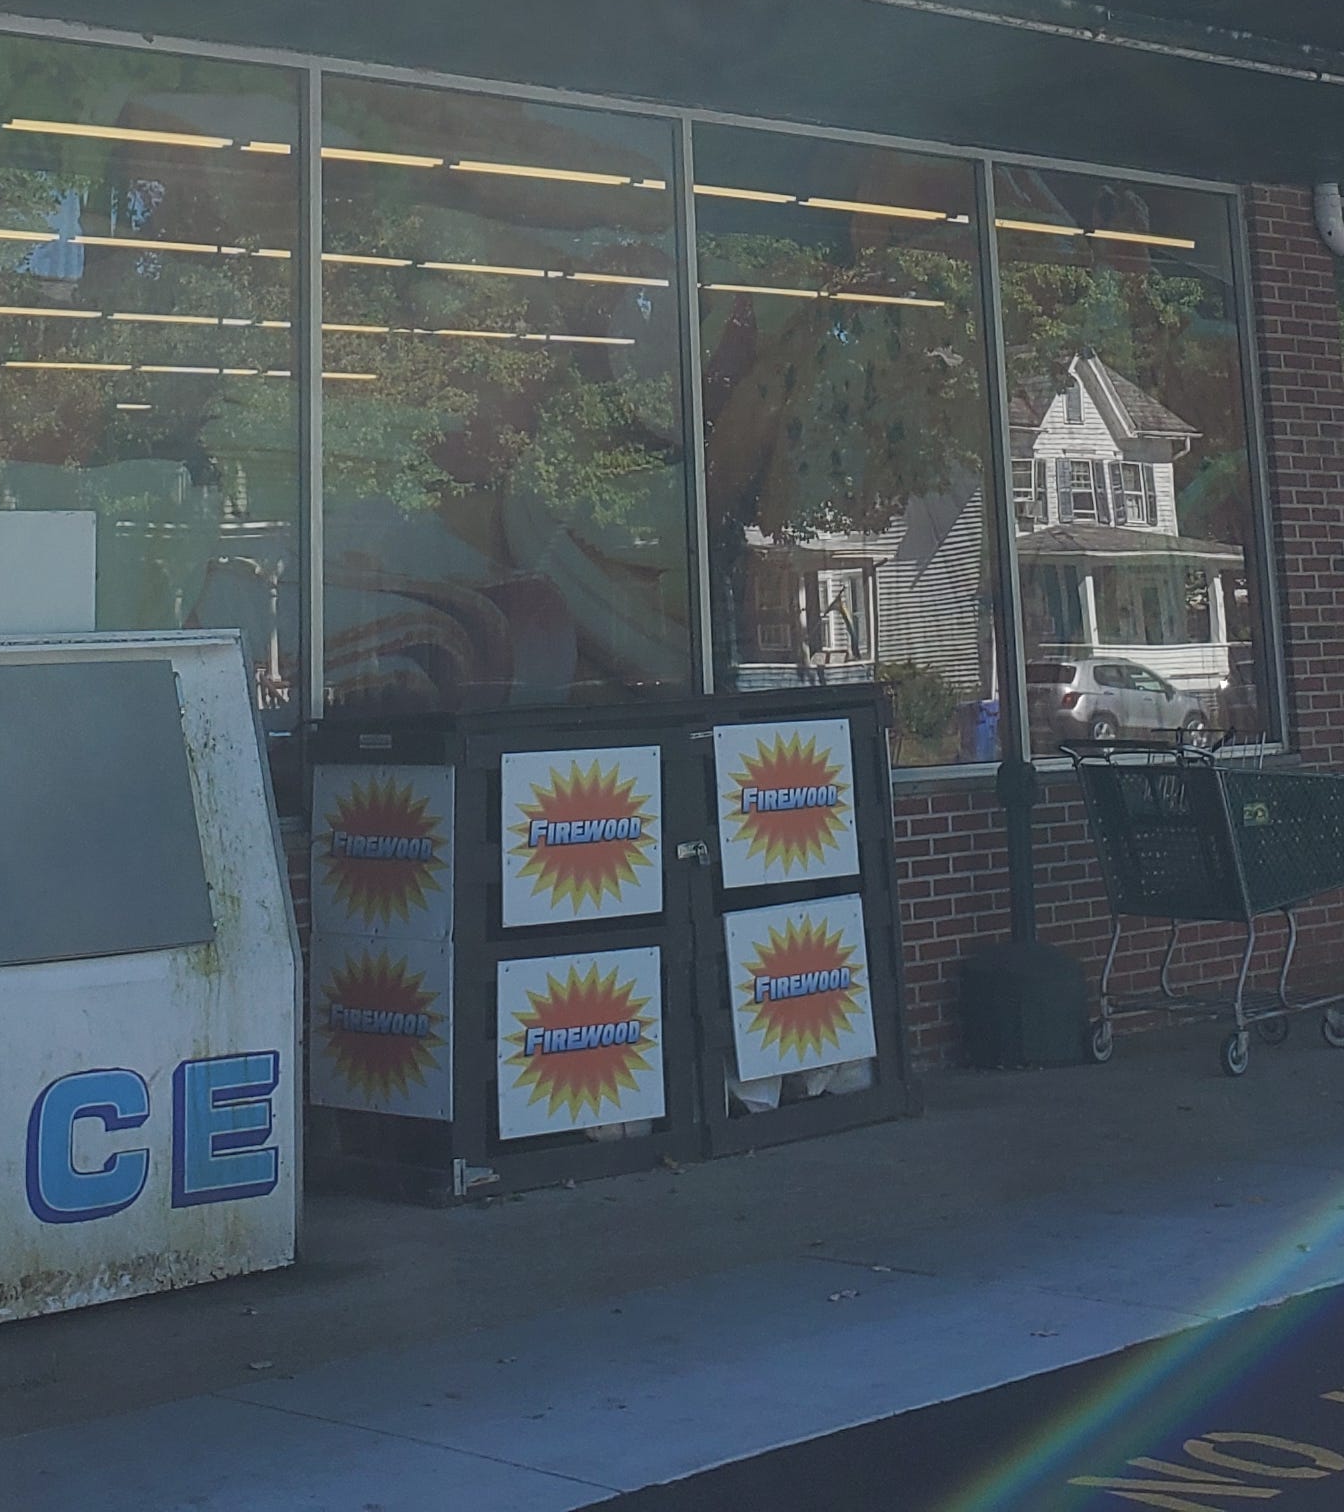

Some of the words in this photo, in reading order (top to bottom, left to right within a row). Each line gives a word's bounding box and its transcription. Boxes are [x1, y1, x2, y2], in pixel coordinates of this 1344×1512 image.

[741, 784, 838, 814] FIREWOOD
[332, 831, 433, 862] FIREWOOD
[528, 816, 642, 848] FIREWOOD
[755, 966, 851, 1003] FIREWOOD
[330, 1002, 430, 1037] FIREWOOD
[524, 1020, 641, 1056] FIREWOOD
